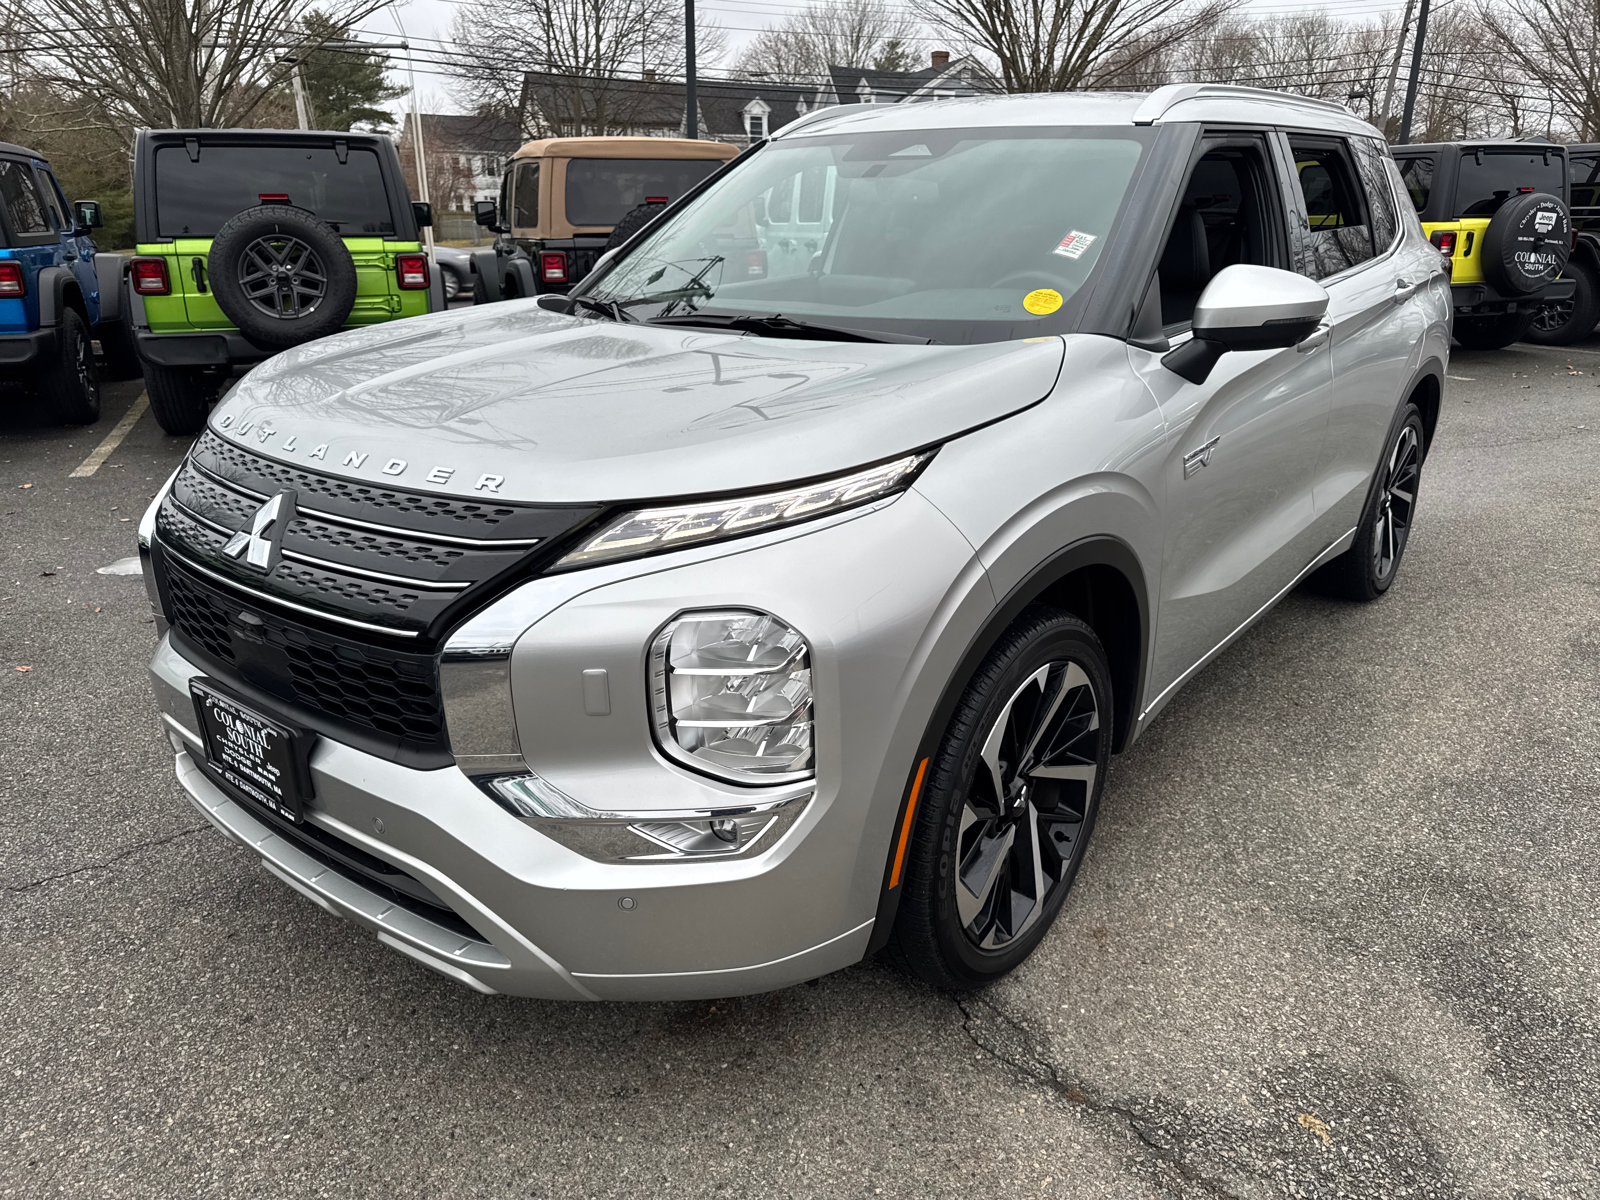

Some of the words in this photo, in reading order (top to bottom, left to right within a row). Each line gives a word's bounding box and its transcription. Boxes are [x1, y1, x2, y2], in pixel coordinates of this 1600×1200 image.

[1538, 213, 1554, 223] Jeep
[1514, 251, 1557, 265] COLONIAL
[1524, 263, 1544, 271] SOUTH
[219, 413, 505, 493] OUTLANDER
[213, 707, 271, 750] COLONIAL
[226, 727, 264, 759] SOUTH
[216, 734, 262, 765] CHRYSLER
[266, 761, 280, 777] Jeep
[224, 746, 252, 768] DODGE
[257, 766, 276, 782] RAM
[273, 784, 283, 796] MA
[268, 799, 277, 811] MA
